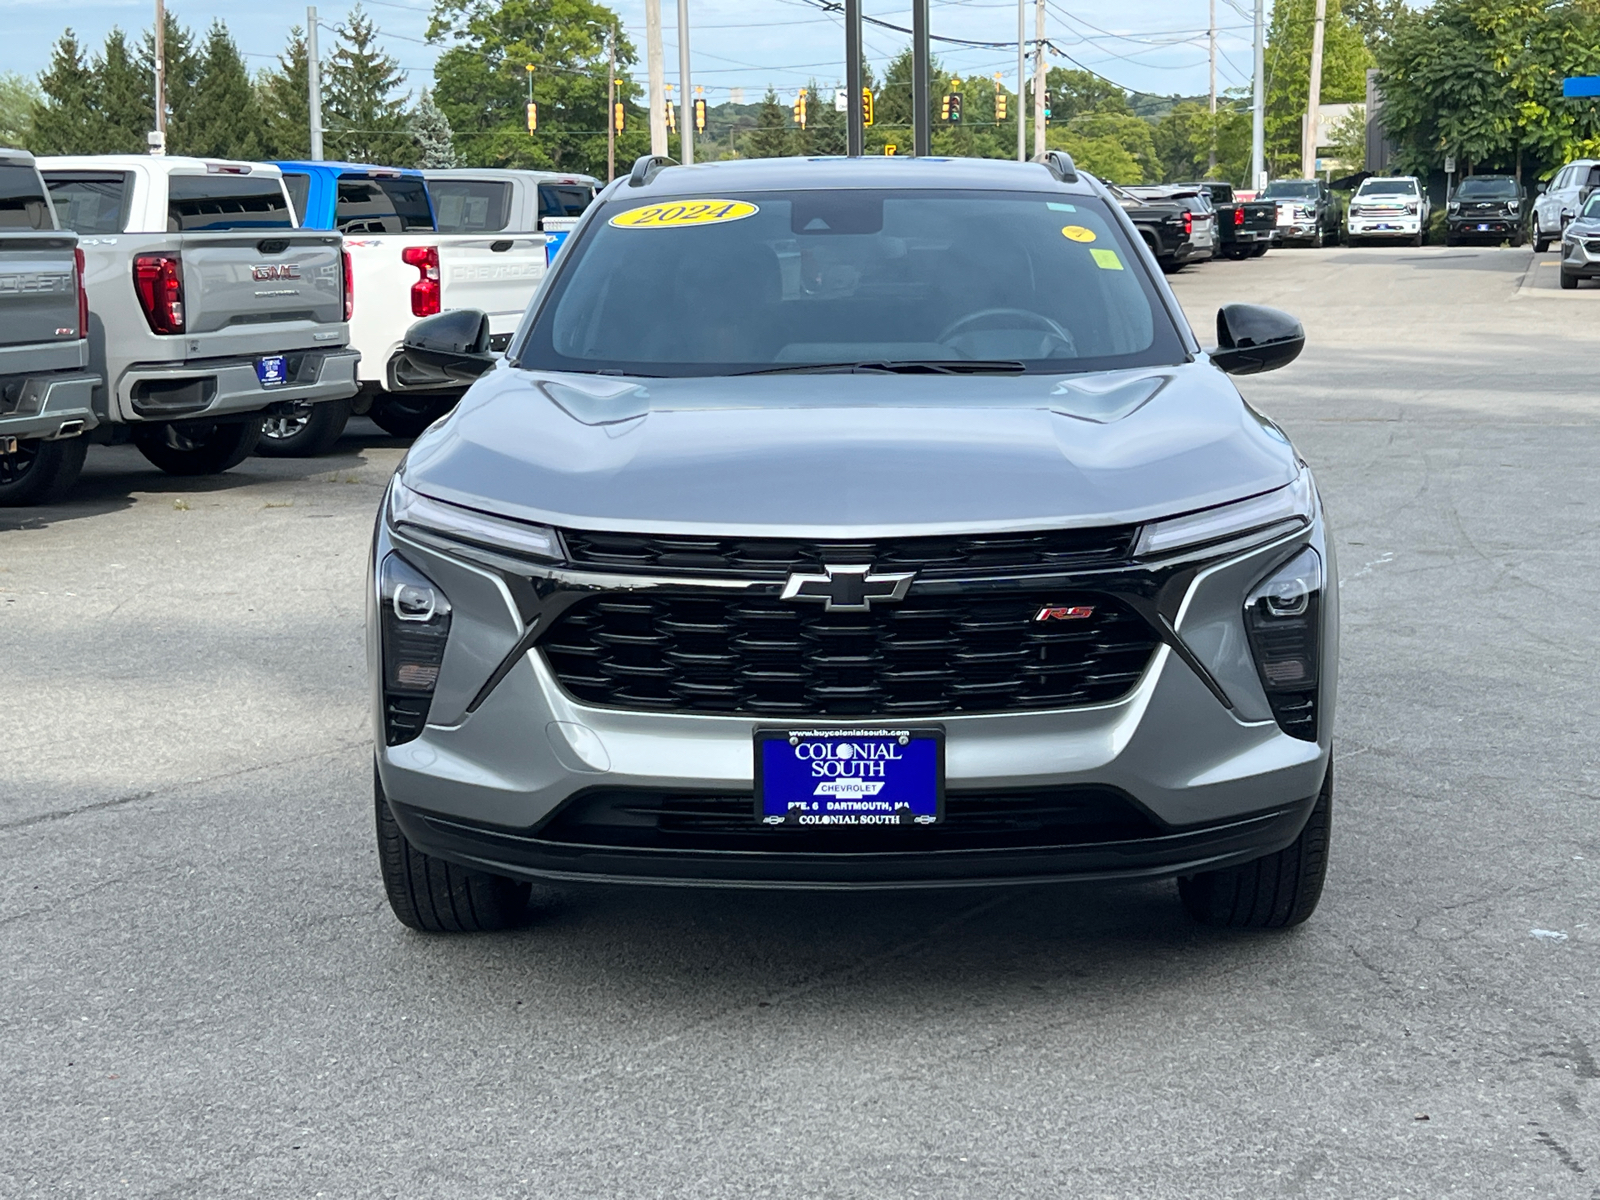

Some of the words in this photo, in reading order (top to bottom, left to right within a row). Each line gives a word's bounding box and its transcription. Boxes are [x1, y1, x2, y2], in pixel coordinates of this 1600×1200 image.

[632, 203, 736, 225] 2024
[252, 263, 301, 281] GMC
[1035, 605, 1095, 621] RS
[789, 729, 910, 738] www.buycolonialsouth.com
[795, 743, 903, 760] COLONIAL
[811, 760, 886, 777] SOUTH
[821, 784, 877, 792] CHEVROLET
[812, 802, 819, 811] 6
[827, 801, 893, 812] DARTMOUTH,
[799, 815, 859, 825] COLONIAL
[860, 815, 900, 825] SOUTH
